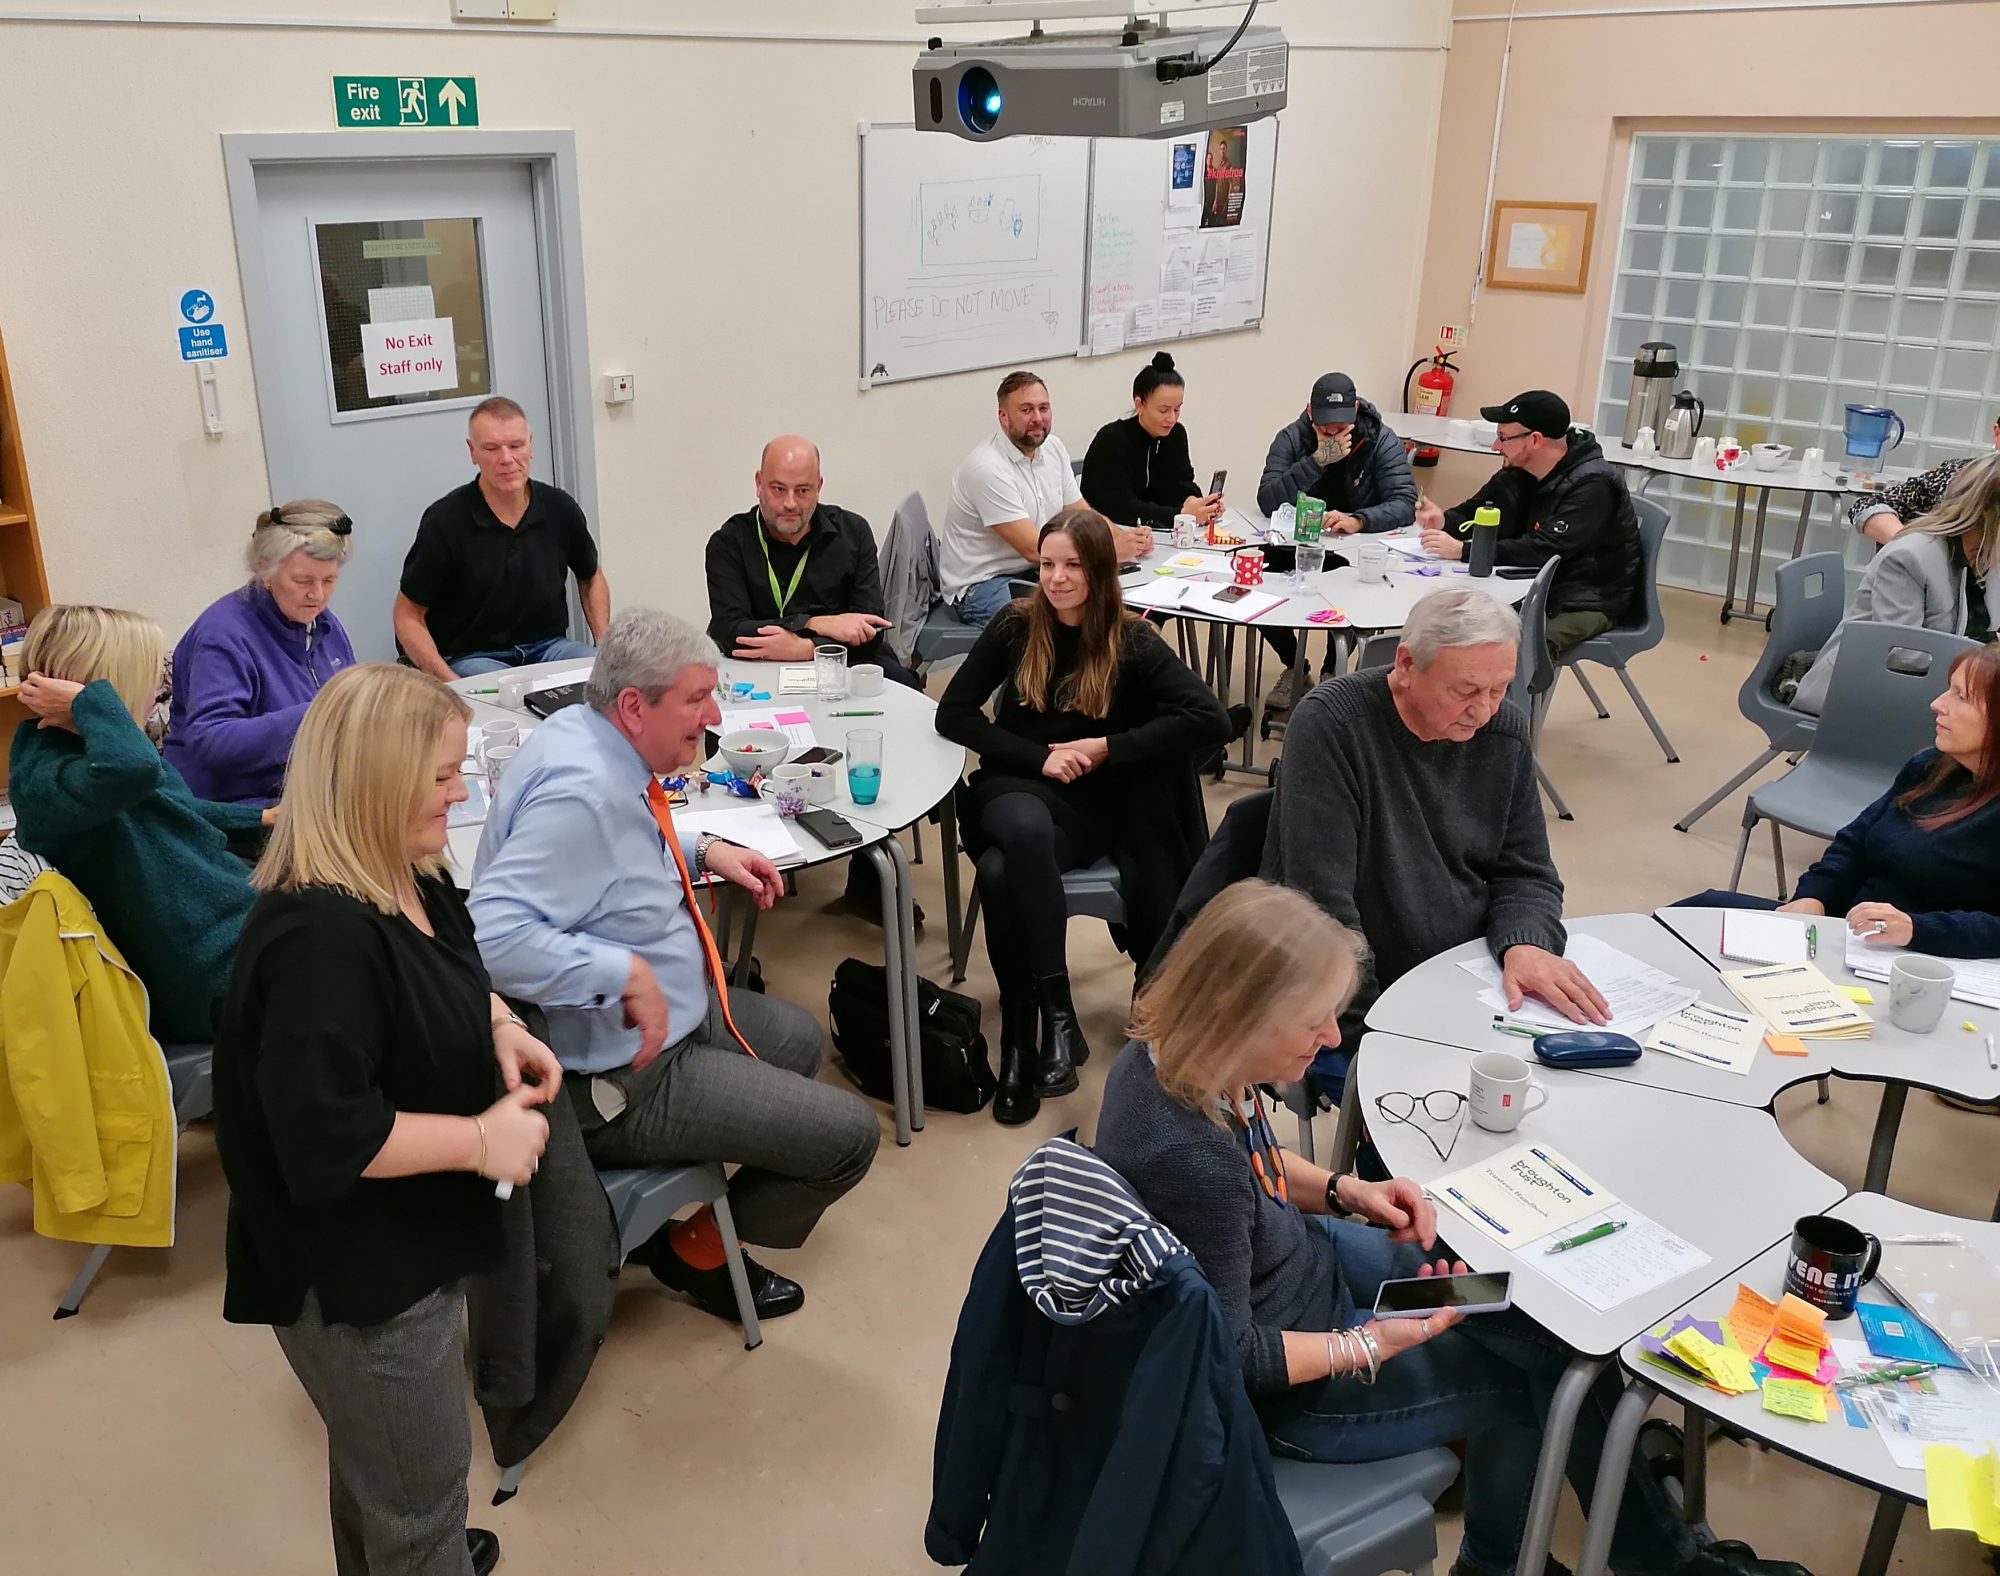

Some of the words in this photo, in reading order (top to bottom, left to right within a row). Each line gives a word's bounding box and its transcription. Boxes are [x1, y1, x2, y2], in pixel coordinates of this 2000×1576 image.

[346, 83, 380, 100] Fire
[1072, 96, 1106, 106] HITACHI
[350, 104, 381, 120] exit
[873, 296, 924, 329] PLEASE
[955, 290, 983, 320] NOT
[990, 284, 1034, 312] MOVE
[193, 328, 211, 337] Use
[190, 337, 213, 347] hand
[385, 337, 405, 350] No
[408, 334, 433, 348] Exit
[186, 347, 224, 358] sanitiser
[379, 359, 411, 375] Staff
[415, 357, 443, 373] only
[1780, 1003, 1841, 1015] broughton
[1680, 1009, 1742, 1032] broughton
[1510, 1164, 1544, 1187] trust
[1516, 1160, 1572, 1204] broughton
[1843, 1271, 1863, 1289] IT
